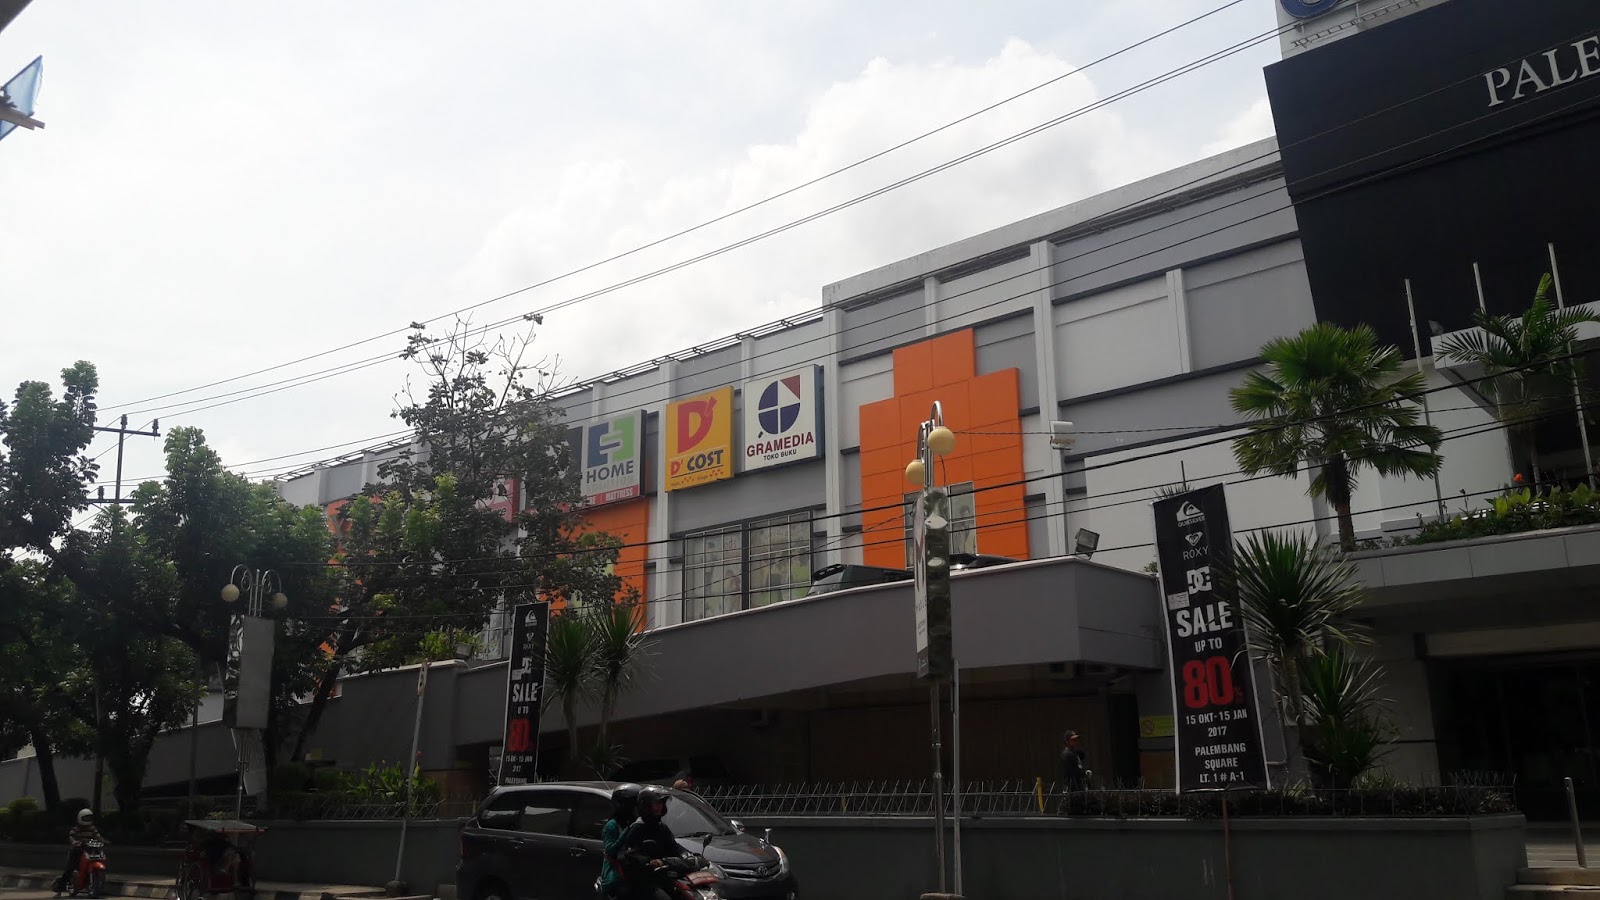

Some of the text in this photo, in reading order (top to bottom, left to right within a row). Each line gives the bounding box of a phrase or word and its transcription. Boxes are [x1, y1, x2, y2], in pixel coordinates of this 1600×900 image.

[747, 432, 814, 457] GRAMEDIA
[687, 449, 724, 471] COST
[764, 449, 797, 461] TOKO BUKU
[586, 460, 634, 484] HOME
[606, 487, 633, 501] MATTRESS
[1183, 545, 1208, 560] ROXY
[1187, 566, 1212, 595] DC
[1176, 601, 1233, 638] SALE
[1195, 637, 1222, 652] UP TO
[1186, 715, 1196, 725] 15
[1219, 711, 1230, 721] 15
[1233, 709, 1247, 720] JAN
[1208, 726, 1227, 738] 2017
[1195, 742, 1246, 756] PALEMBANG
[1205, 757, 1238, 771] SQUARE
[1200, 773, 1210, 783] LT.
[1214, 773, 1218, 782] 1
[1230, 771, 1244, 781] A-1
